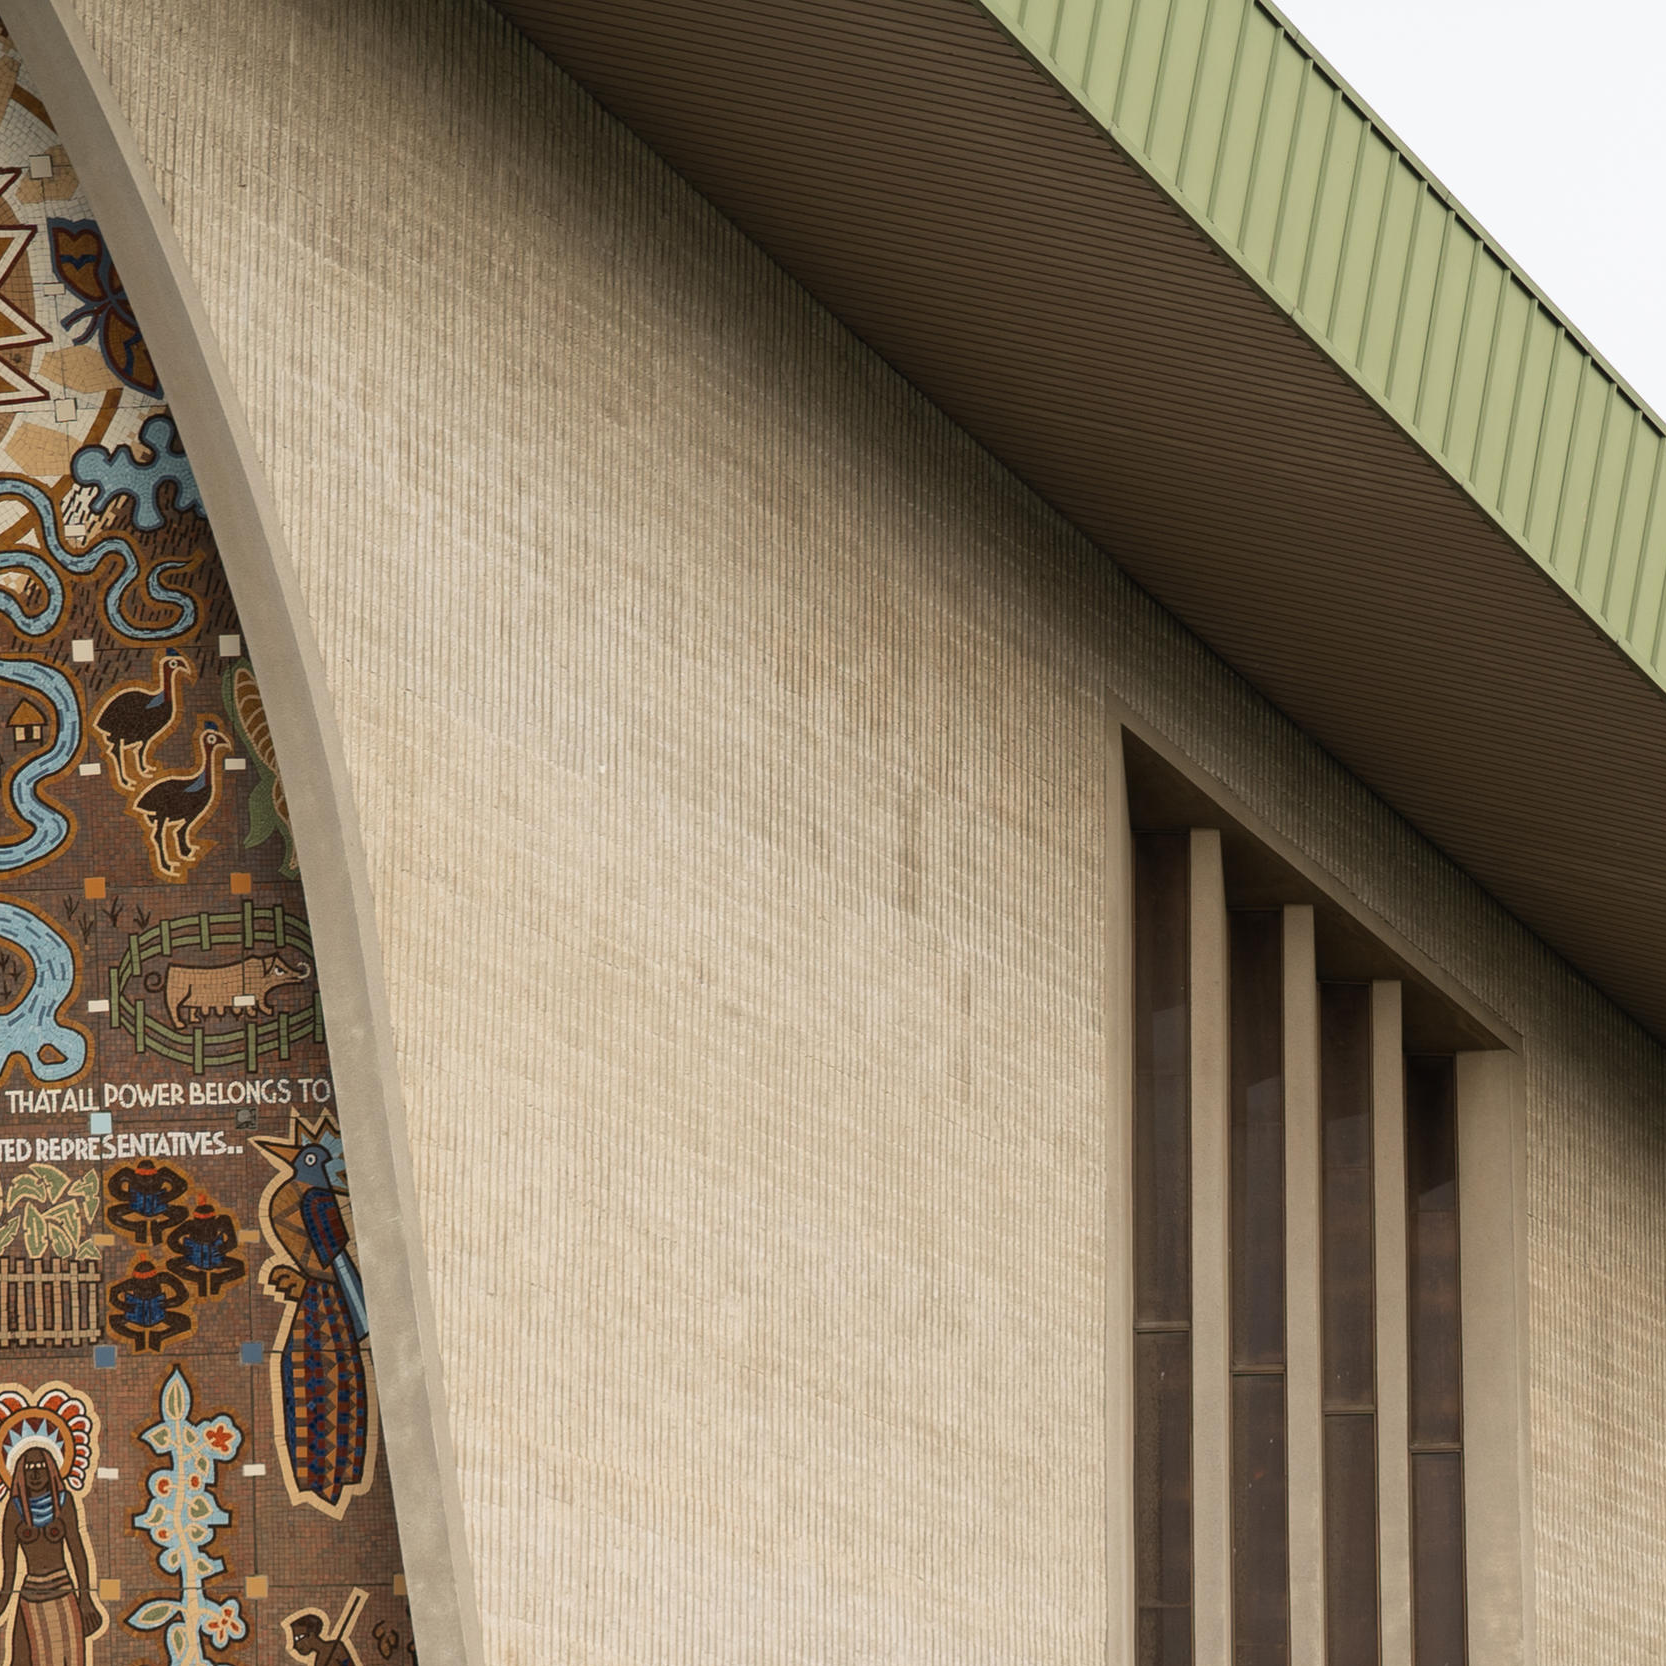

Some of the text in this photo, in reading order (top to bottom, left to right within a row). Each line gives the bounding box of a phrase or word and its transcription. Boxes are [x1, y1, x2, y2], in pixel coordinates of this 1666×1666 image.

[5, 1088, 61, 1114] THAT
[61, 1087, 100, 1113] ALL
[104, 1082, 185, 1108] POWER
[189, 1079, 291, 1105] BELONGS
[298, 1078, 331, 1103] TO
